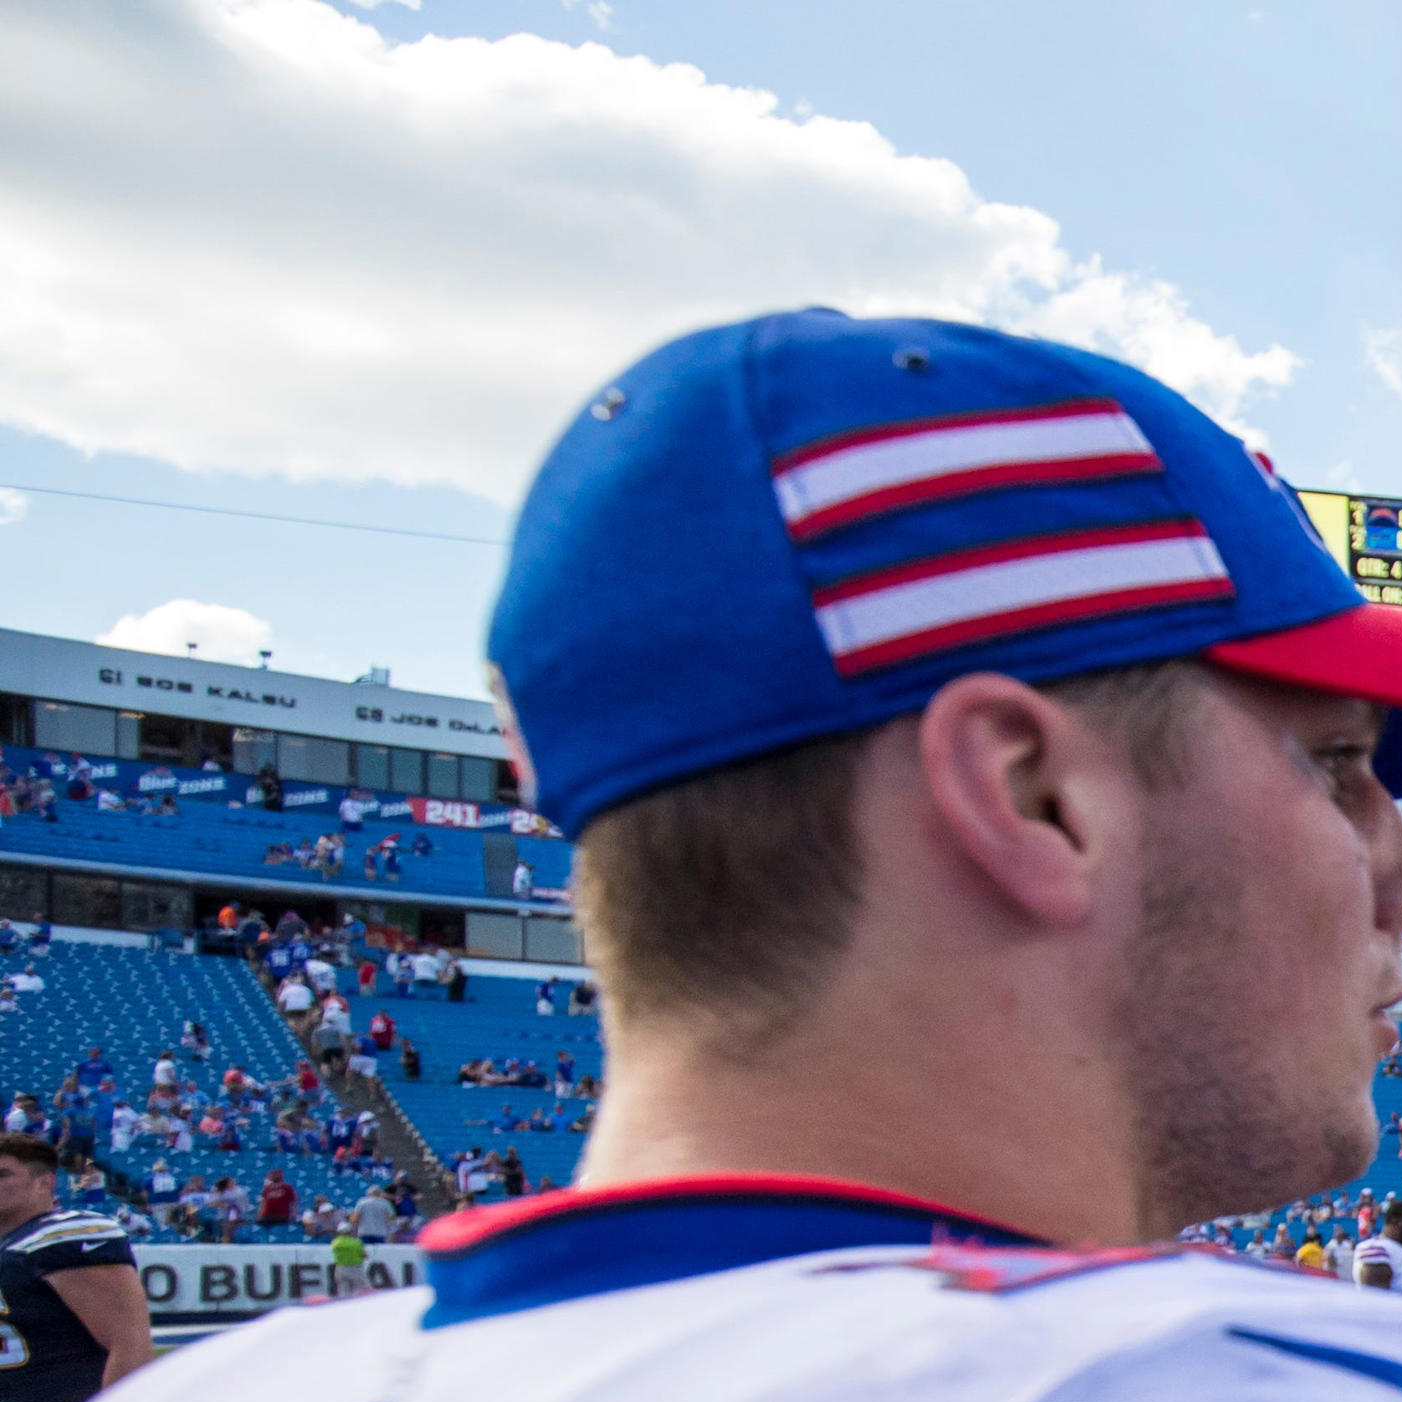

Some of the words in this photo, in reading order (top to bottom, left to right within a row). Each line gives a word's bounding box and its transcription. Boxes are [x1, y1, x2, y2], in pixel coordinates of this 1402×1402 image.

[137, 676, 193, 693] BOB
[390, 715, 439, 728] JOE
[425, 801, 480, 826] 241
